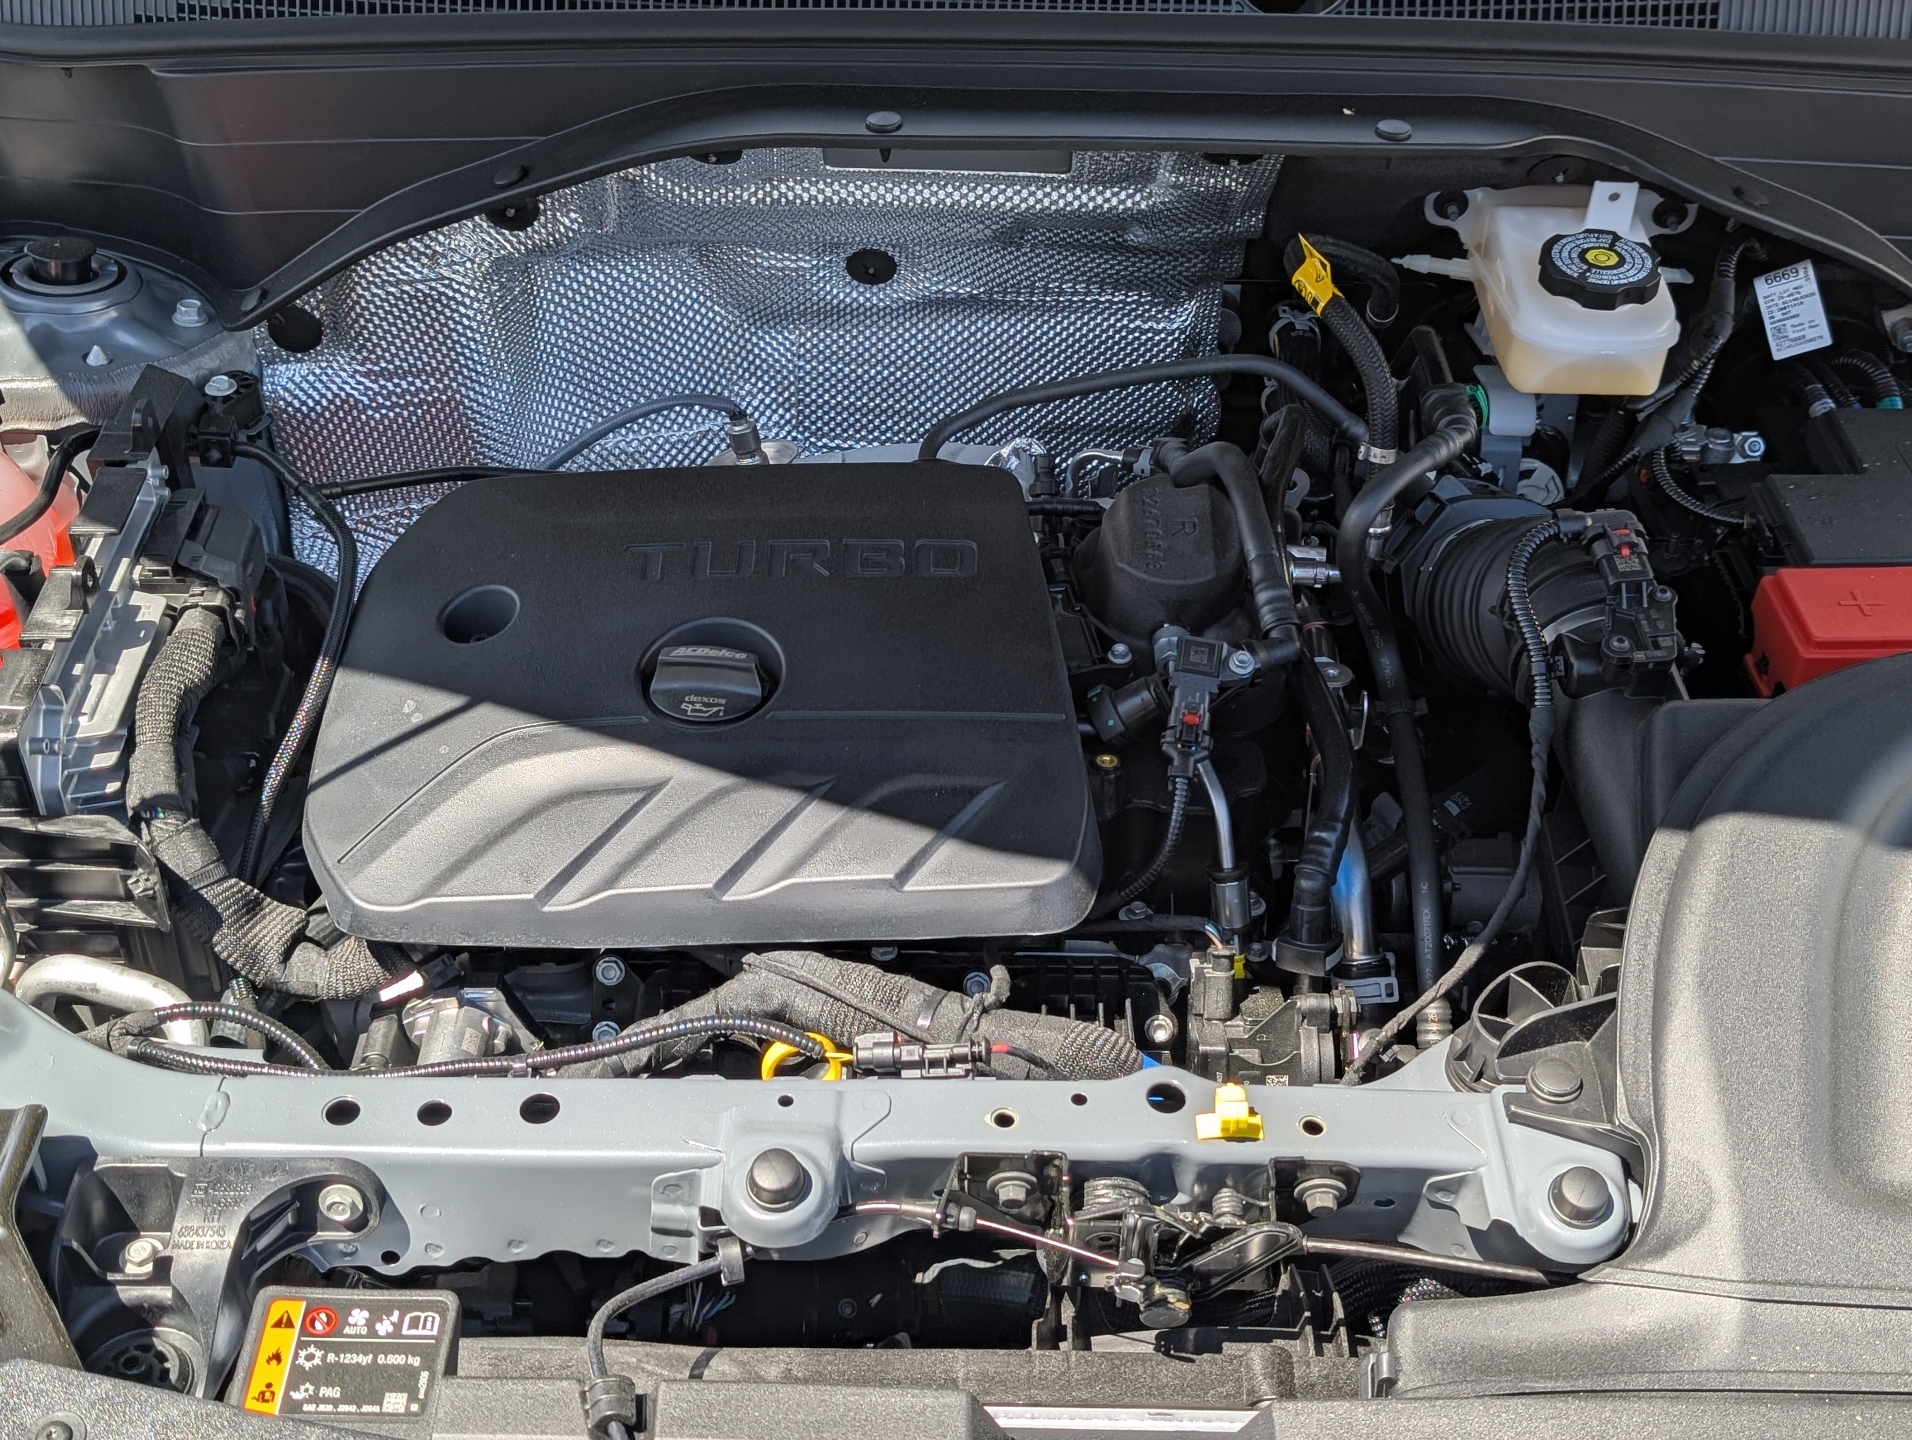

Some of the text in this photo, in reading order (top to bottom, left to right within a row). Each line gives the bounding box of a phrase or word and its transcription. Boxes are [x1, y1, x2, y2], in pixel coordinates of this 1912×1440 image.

[1764, 267, 1799, 285] 6669
[623, 539, 978, 580] TURBO
[669, 647, 747, 659] ACDelco
[685, 694, 727, 704] dexos
[1420, 881, 1428, 893] NC
[1422, 907, 1433, 960] AT200717EX
[203, 1209, 221, 1223] RH
[172, 1240, 232, 1250] MADE IN KOREA
[343, 1326, 368, 1335] AUTO
[326, 1354, 420, 1366] R-1234yf 0.600 kg
[319, 1386, 341, 1399] PAG
